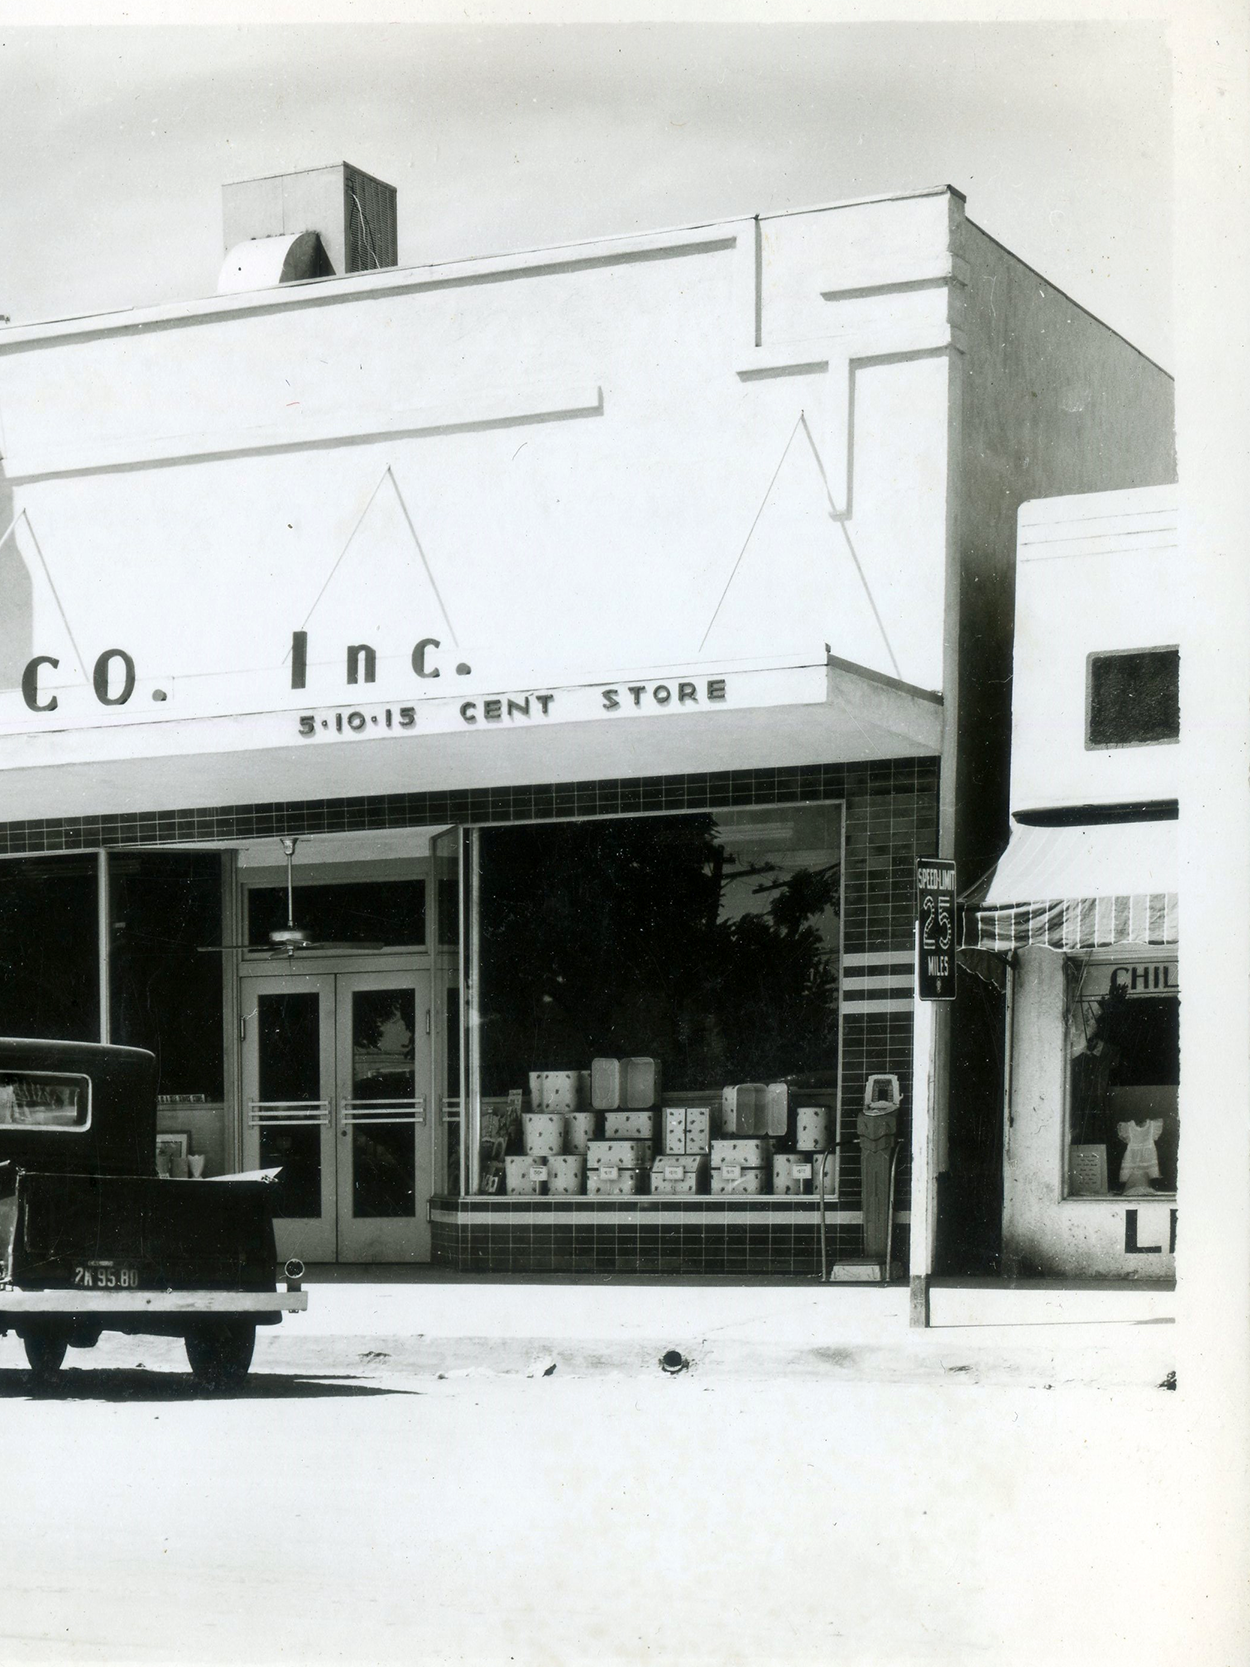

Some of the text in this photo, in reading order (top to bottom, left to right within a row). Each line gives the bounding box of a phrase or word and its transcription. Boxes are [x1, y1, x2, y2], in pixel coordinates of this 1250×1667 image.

[21, 648, 168, 712] CO.
[291, 630, 472, 690] Inc.
[459, 694, 555, 723] CENT
[601, 679, 727, 711] STORE
[923, 896, 951, 949] 25
[928, 956, 948, 976] MILES
